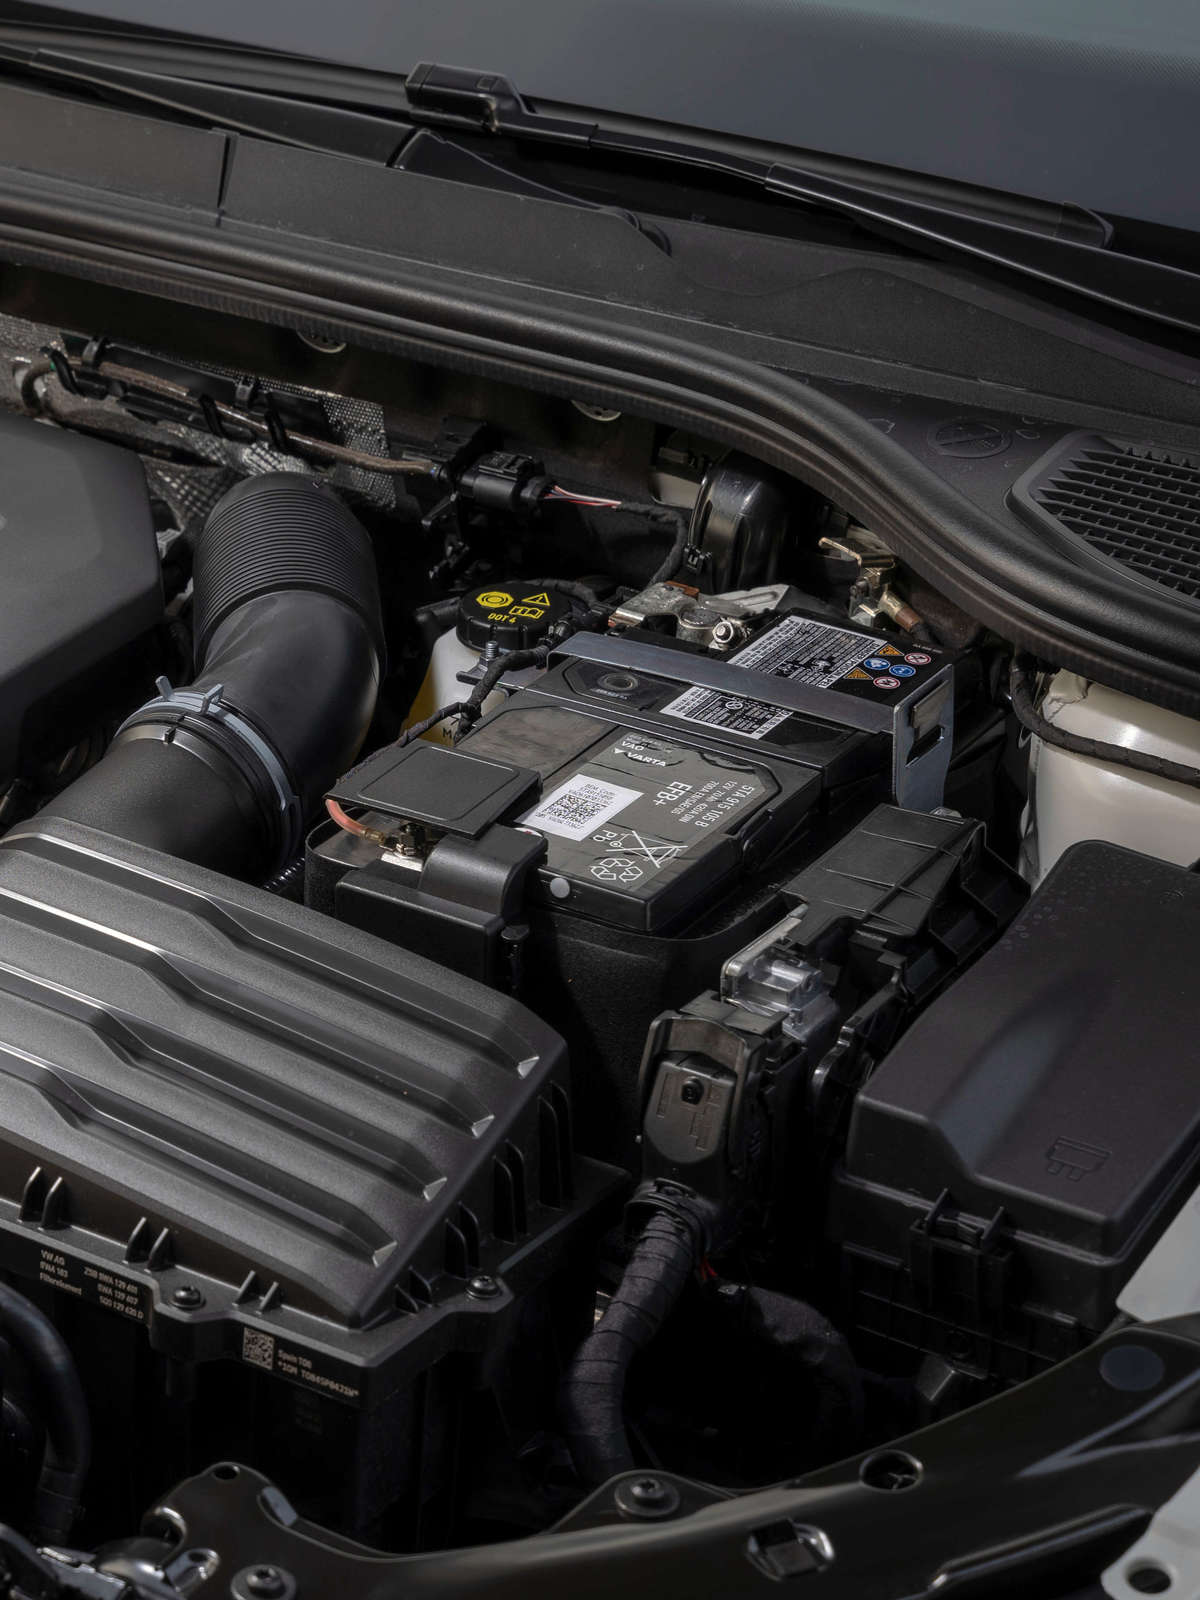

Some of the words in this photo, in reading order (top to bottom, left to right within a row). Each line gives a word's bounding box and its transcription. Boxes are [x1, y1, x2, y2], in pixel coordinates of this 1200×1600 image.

[487, 612, 509, 622] DOT
[627, 751, 666, 767] VARTA
[722, 780, 738, 790] 12V
[731, 784, 755, 798] 5TA
[653, 781, 693, 805] EFB+
[717, 796, 740, 810] 915
[702, 809, 723, 822] 105
[694, 820, 710, 828] B
[593, 829, 618, 842] Pb
